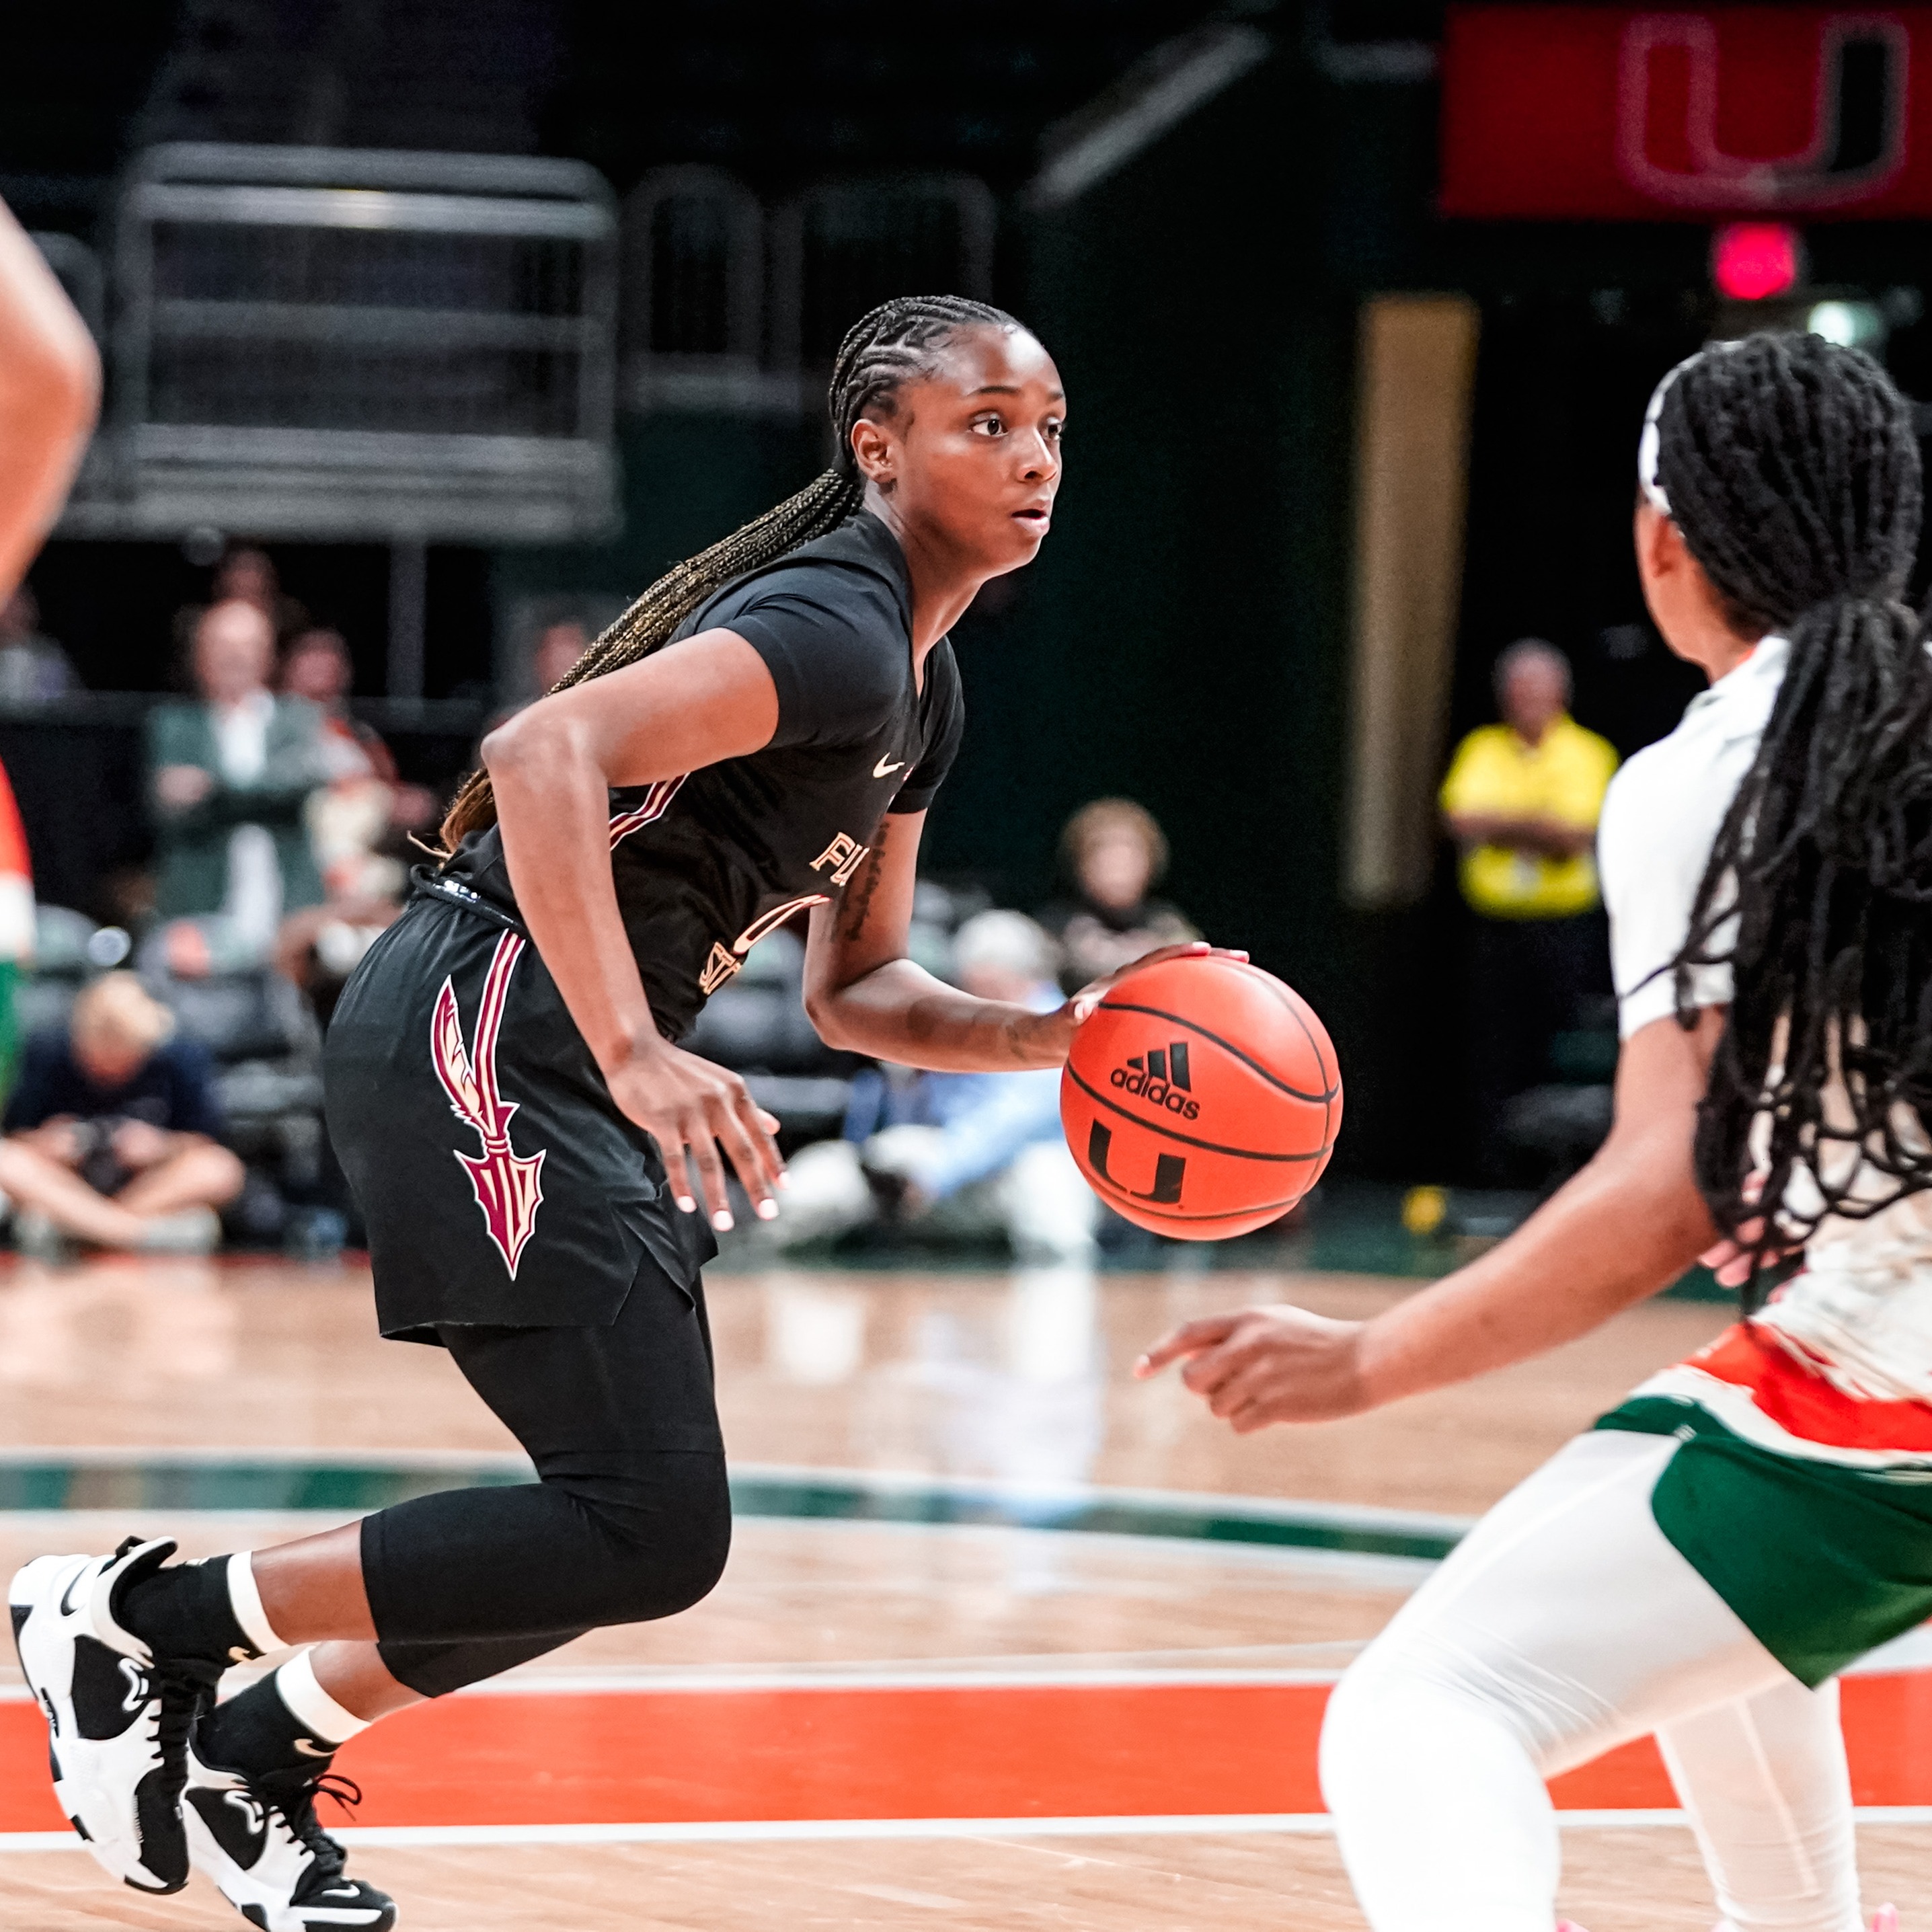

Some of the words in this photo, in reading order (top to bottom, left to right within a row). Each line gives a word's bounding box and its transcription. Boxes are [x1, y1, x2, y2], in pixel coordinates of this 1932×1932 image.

[1619, 12, 1911, 210] U
[1110, 1067, 1200, 1120] adidas
[1088, 1118, 1186, 1204] U
